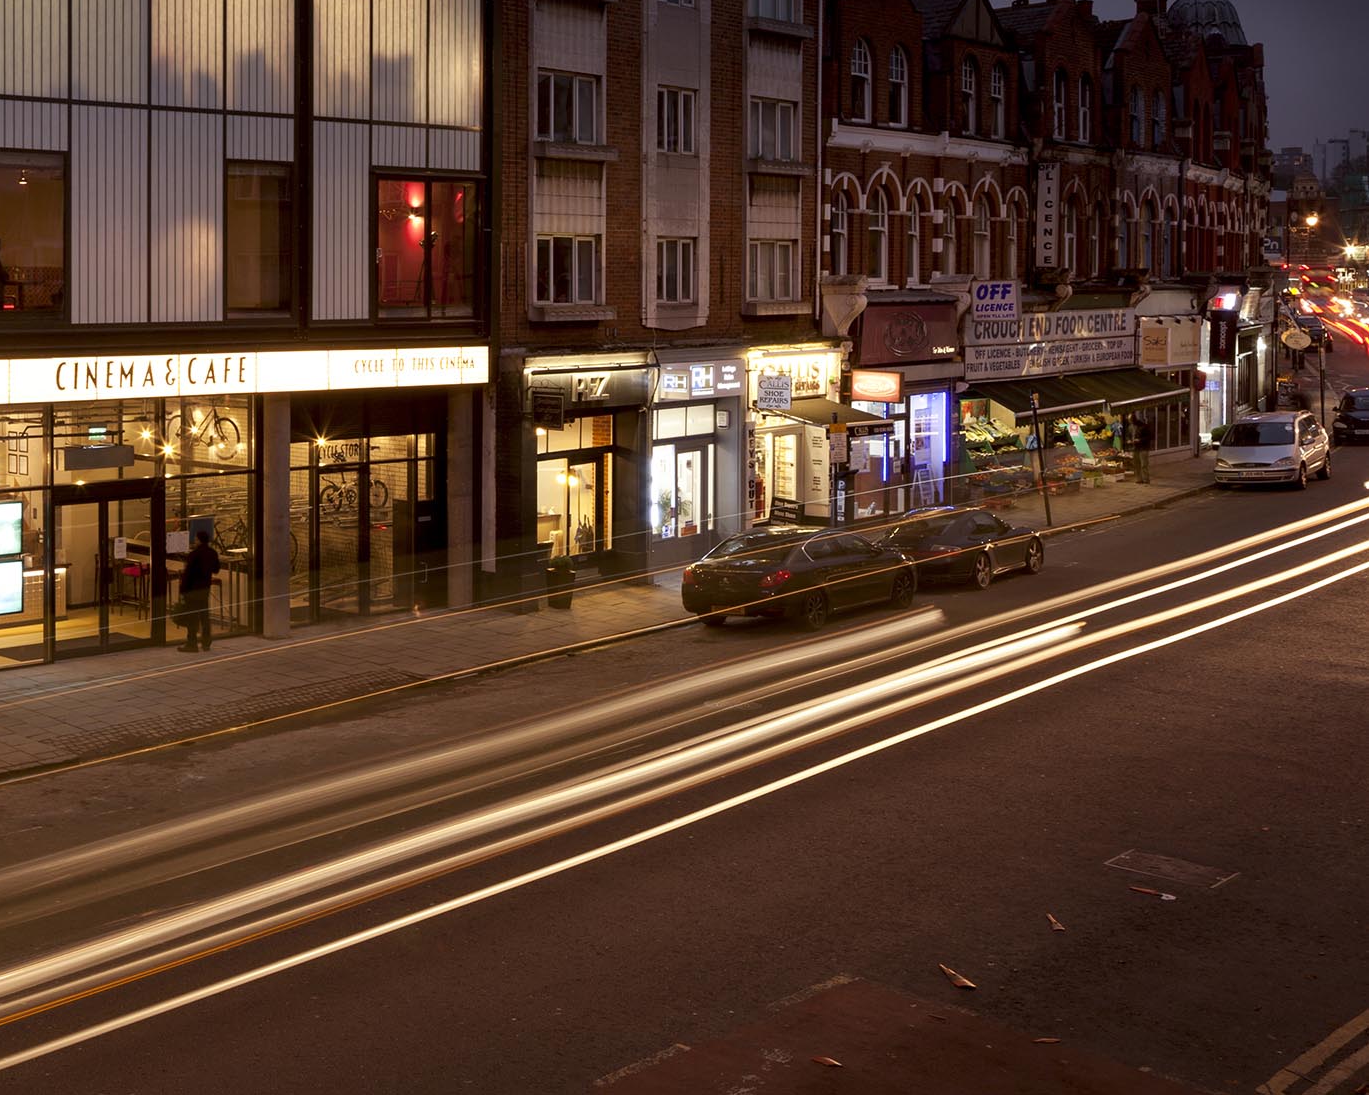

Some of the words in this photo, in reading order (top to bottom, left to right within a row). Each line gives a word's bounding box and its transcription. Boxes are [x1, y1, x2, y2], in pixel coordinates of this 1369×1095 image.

[1043, 171, 1054, 264] LICENCE
[976, 283, 1012, 300] OFF
[975, 303, 1015, 312] LICENCE
[974, 320, 1025, 339] CROUCH
[1029, 316, 1051, 337] END
[1055, 315, 1084, 335] FOOD
[1087, 312, 1127, 333] CENTRE
[974, 349, 986, 360] OFF
[987, 347, 1012, 359] LICENCE
[1106, 340, 1116, 351] TOP
[1096, 351, 1121, 363] EUROPEAN
[354, 359, 384, 373] CYCLE
[392, 357, 405, 371] TO
[412, 356, 435, 371] THIS
[439, 355, 475, 370] CINEMA
[966, 361, 984, 373] FRUIT
[989, 359, 1021, 371] VEGETABLES
[55, 360, 155, 391] CINEMA
[165, 357, 176, 386] &
[187, 356, 247, 385] CAFE
[663, 374, 687, 389] RH
[759, 379, 790, 390] CALLIS
[759, 396, 789, 405] REPAIRS
[748, 429, 756, 469] KEYS
